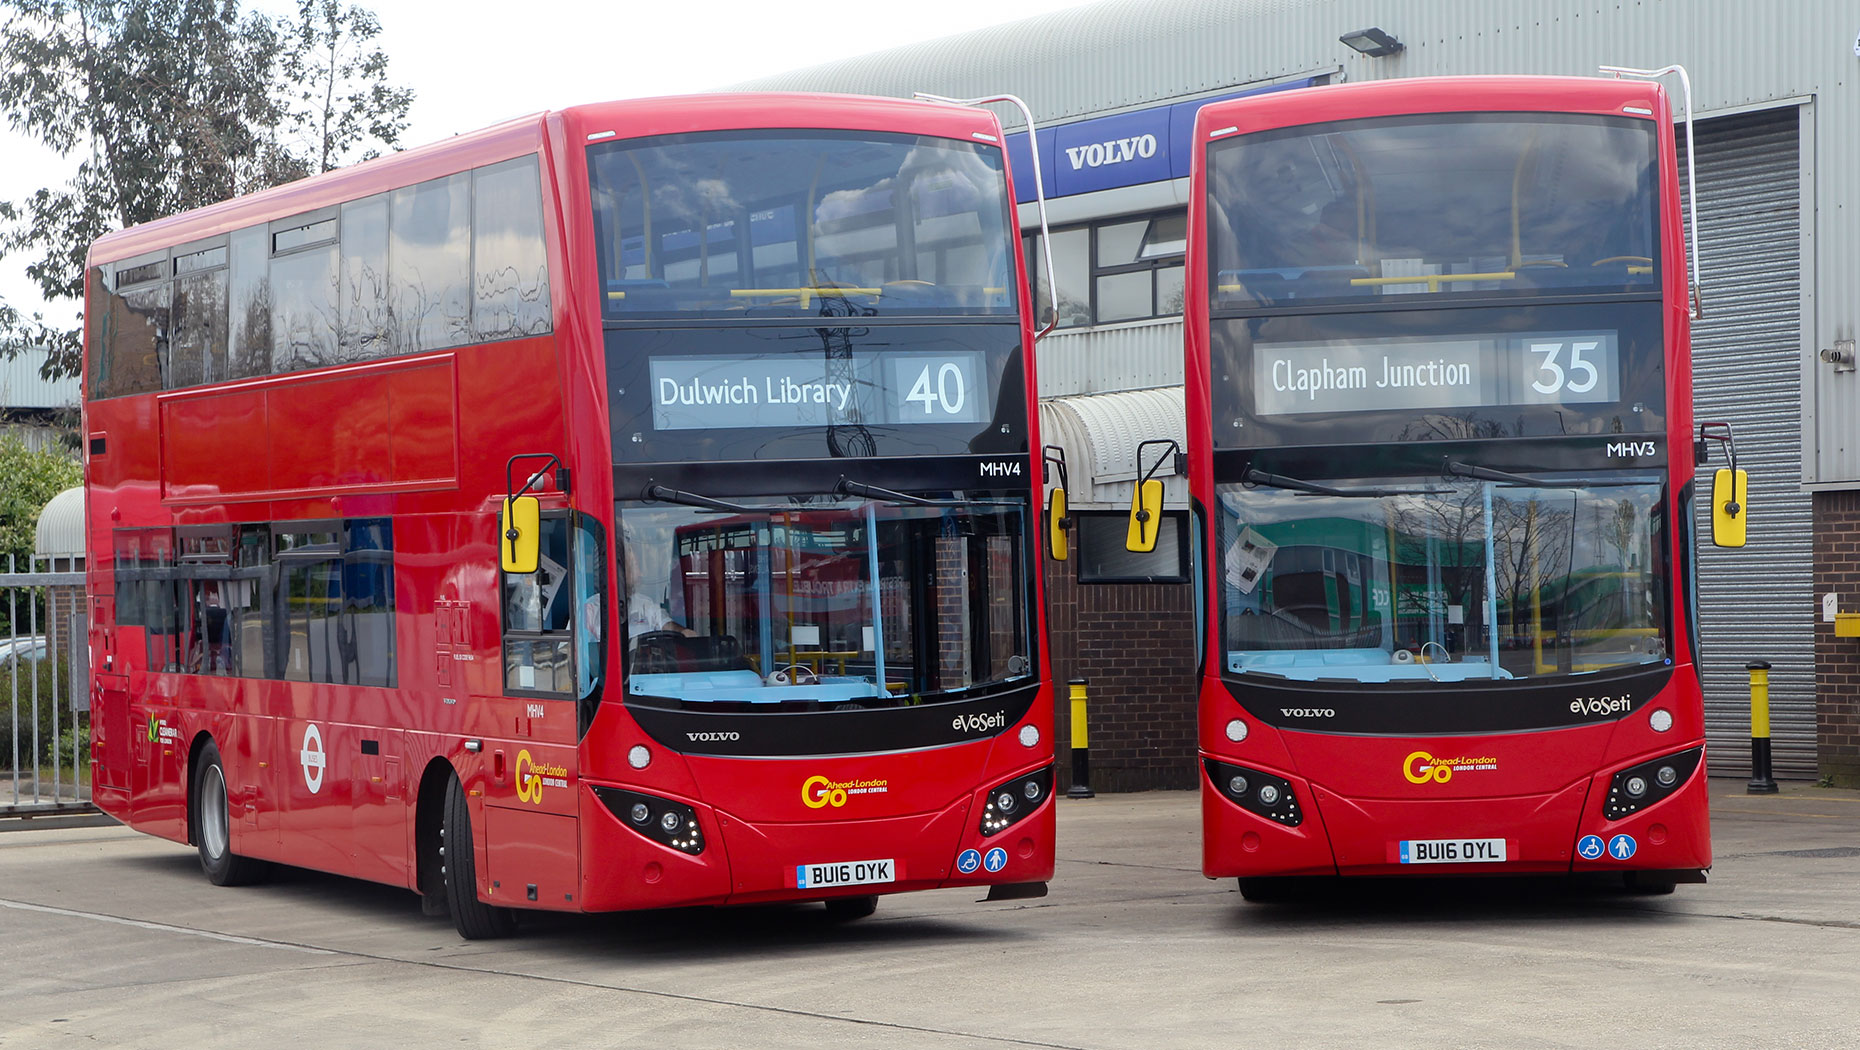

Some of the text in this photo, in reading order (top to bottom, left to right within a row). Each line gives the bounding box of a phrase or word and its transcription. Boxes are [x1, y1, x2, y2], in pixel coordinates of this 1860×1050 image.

[1065, 133, 1157, 170] VOLVO
[1272, 356, 1470, 401] Clapham Junction
[1530, 342, 1599, 395] 35
[659, 376, 851, 411] Dulwich Library
[905, 362, 965, 414] 40
[1607, 441, 1656, 457] MHV3
[980, 462, 1021, 476] MHV4
[526, 703, 544, 718] MHV4
[1280, 708, 1335, 718] VOLVO
[686, 731, 740, 742] VOLVO
[515, 749, 543, 805] Go
[1403, 751, 1452, 784] Go
[801, 775, 847, 809] Go
[1416, 842, 1500, 860] BU16 OYL
[812, 862, 889, 884] BU16 OYK
